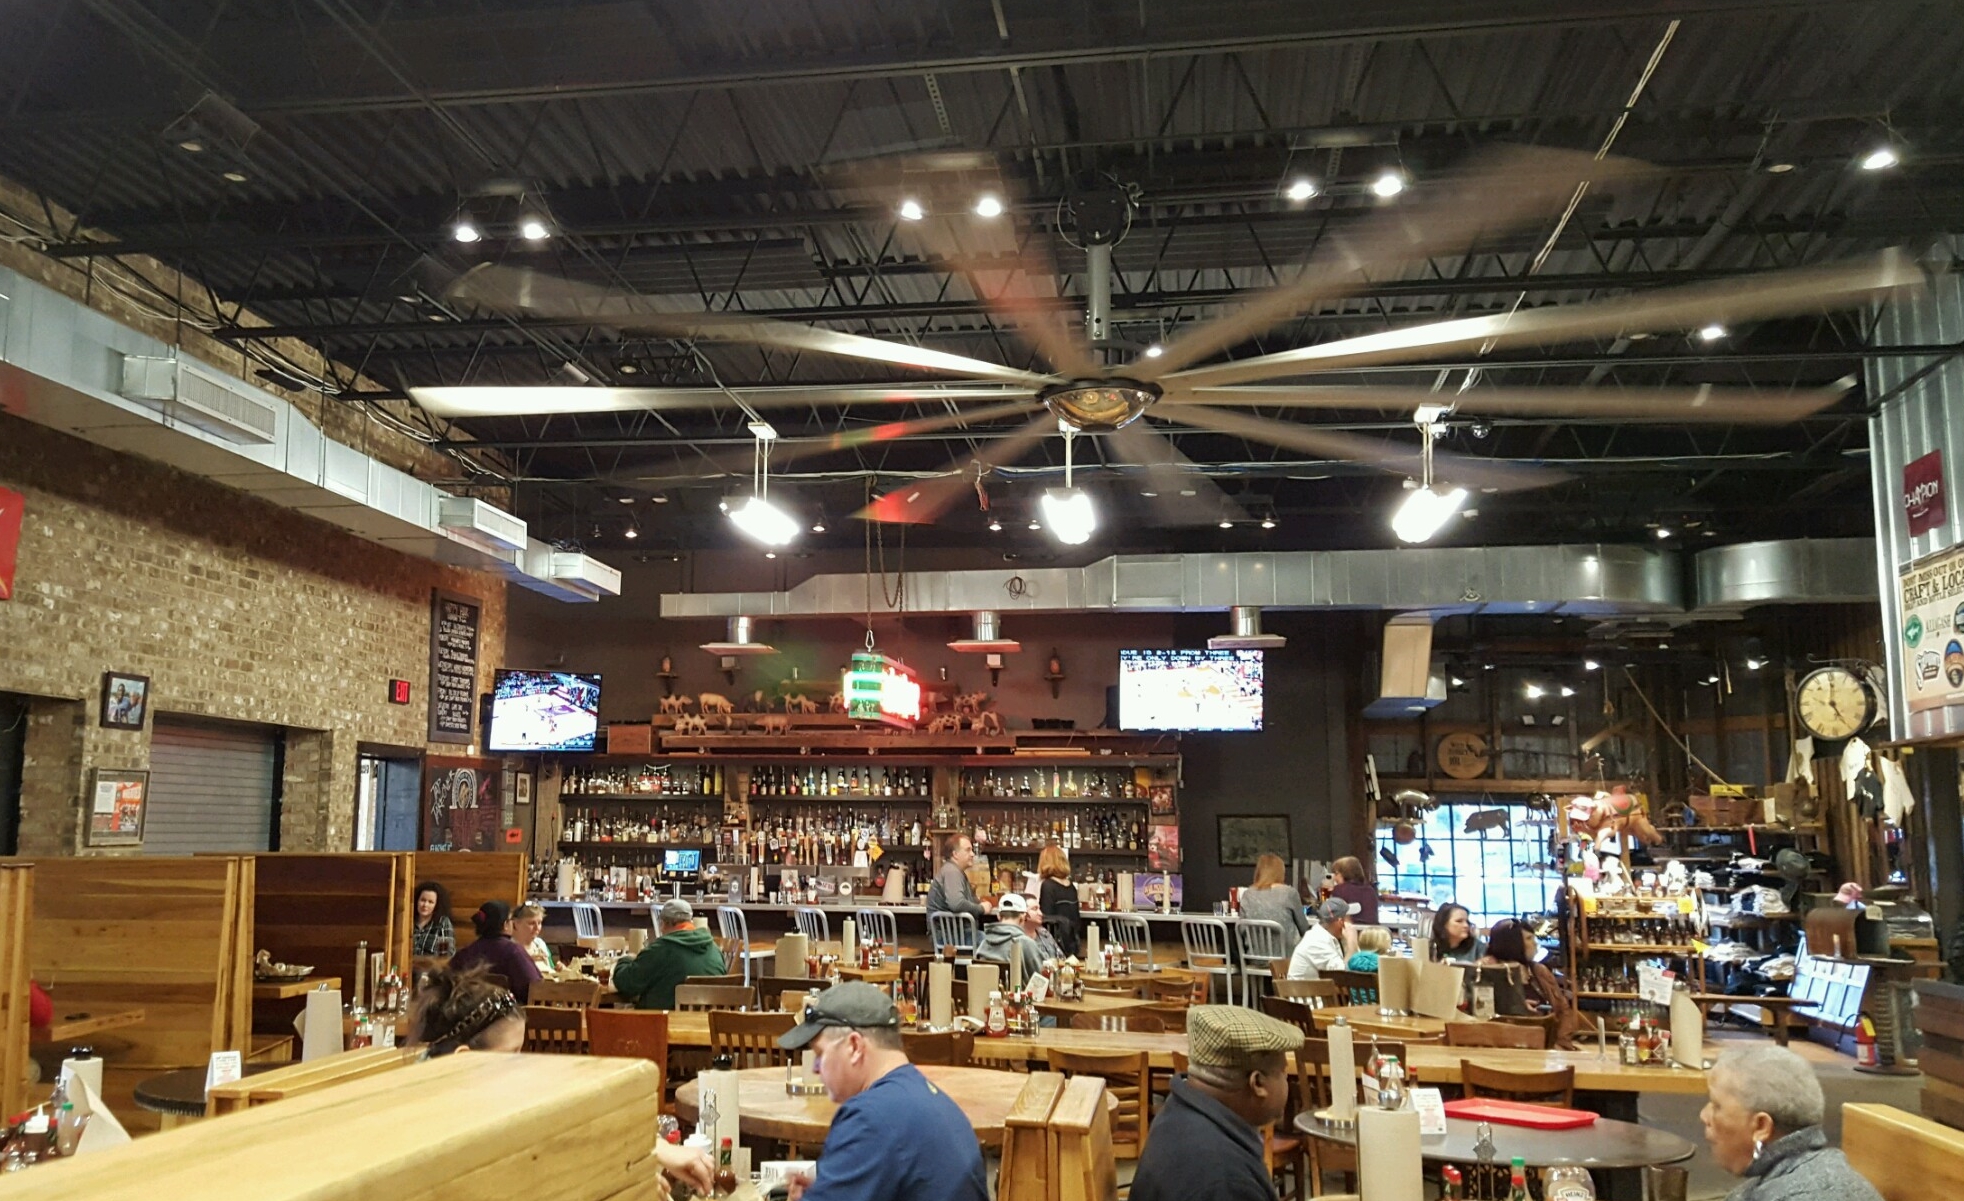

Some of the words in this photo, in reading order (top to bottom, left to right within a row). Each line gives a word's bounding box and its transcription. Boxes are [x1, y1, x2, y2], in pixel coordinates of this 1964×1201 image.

[1932, 564, 1947, 578] OUT
[1904, 581, 1930, 604] CRAFT
[1932, 579, 1940, 594] &
[396, 681, 408, 703] EXIT
